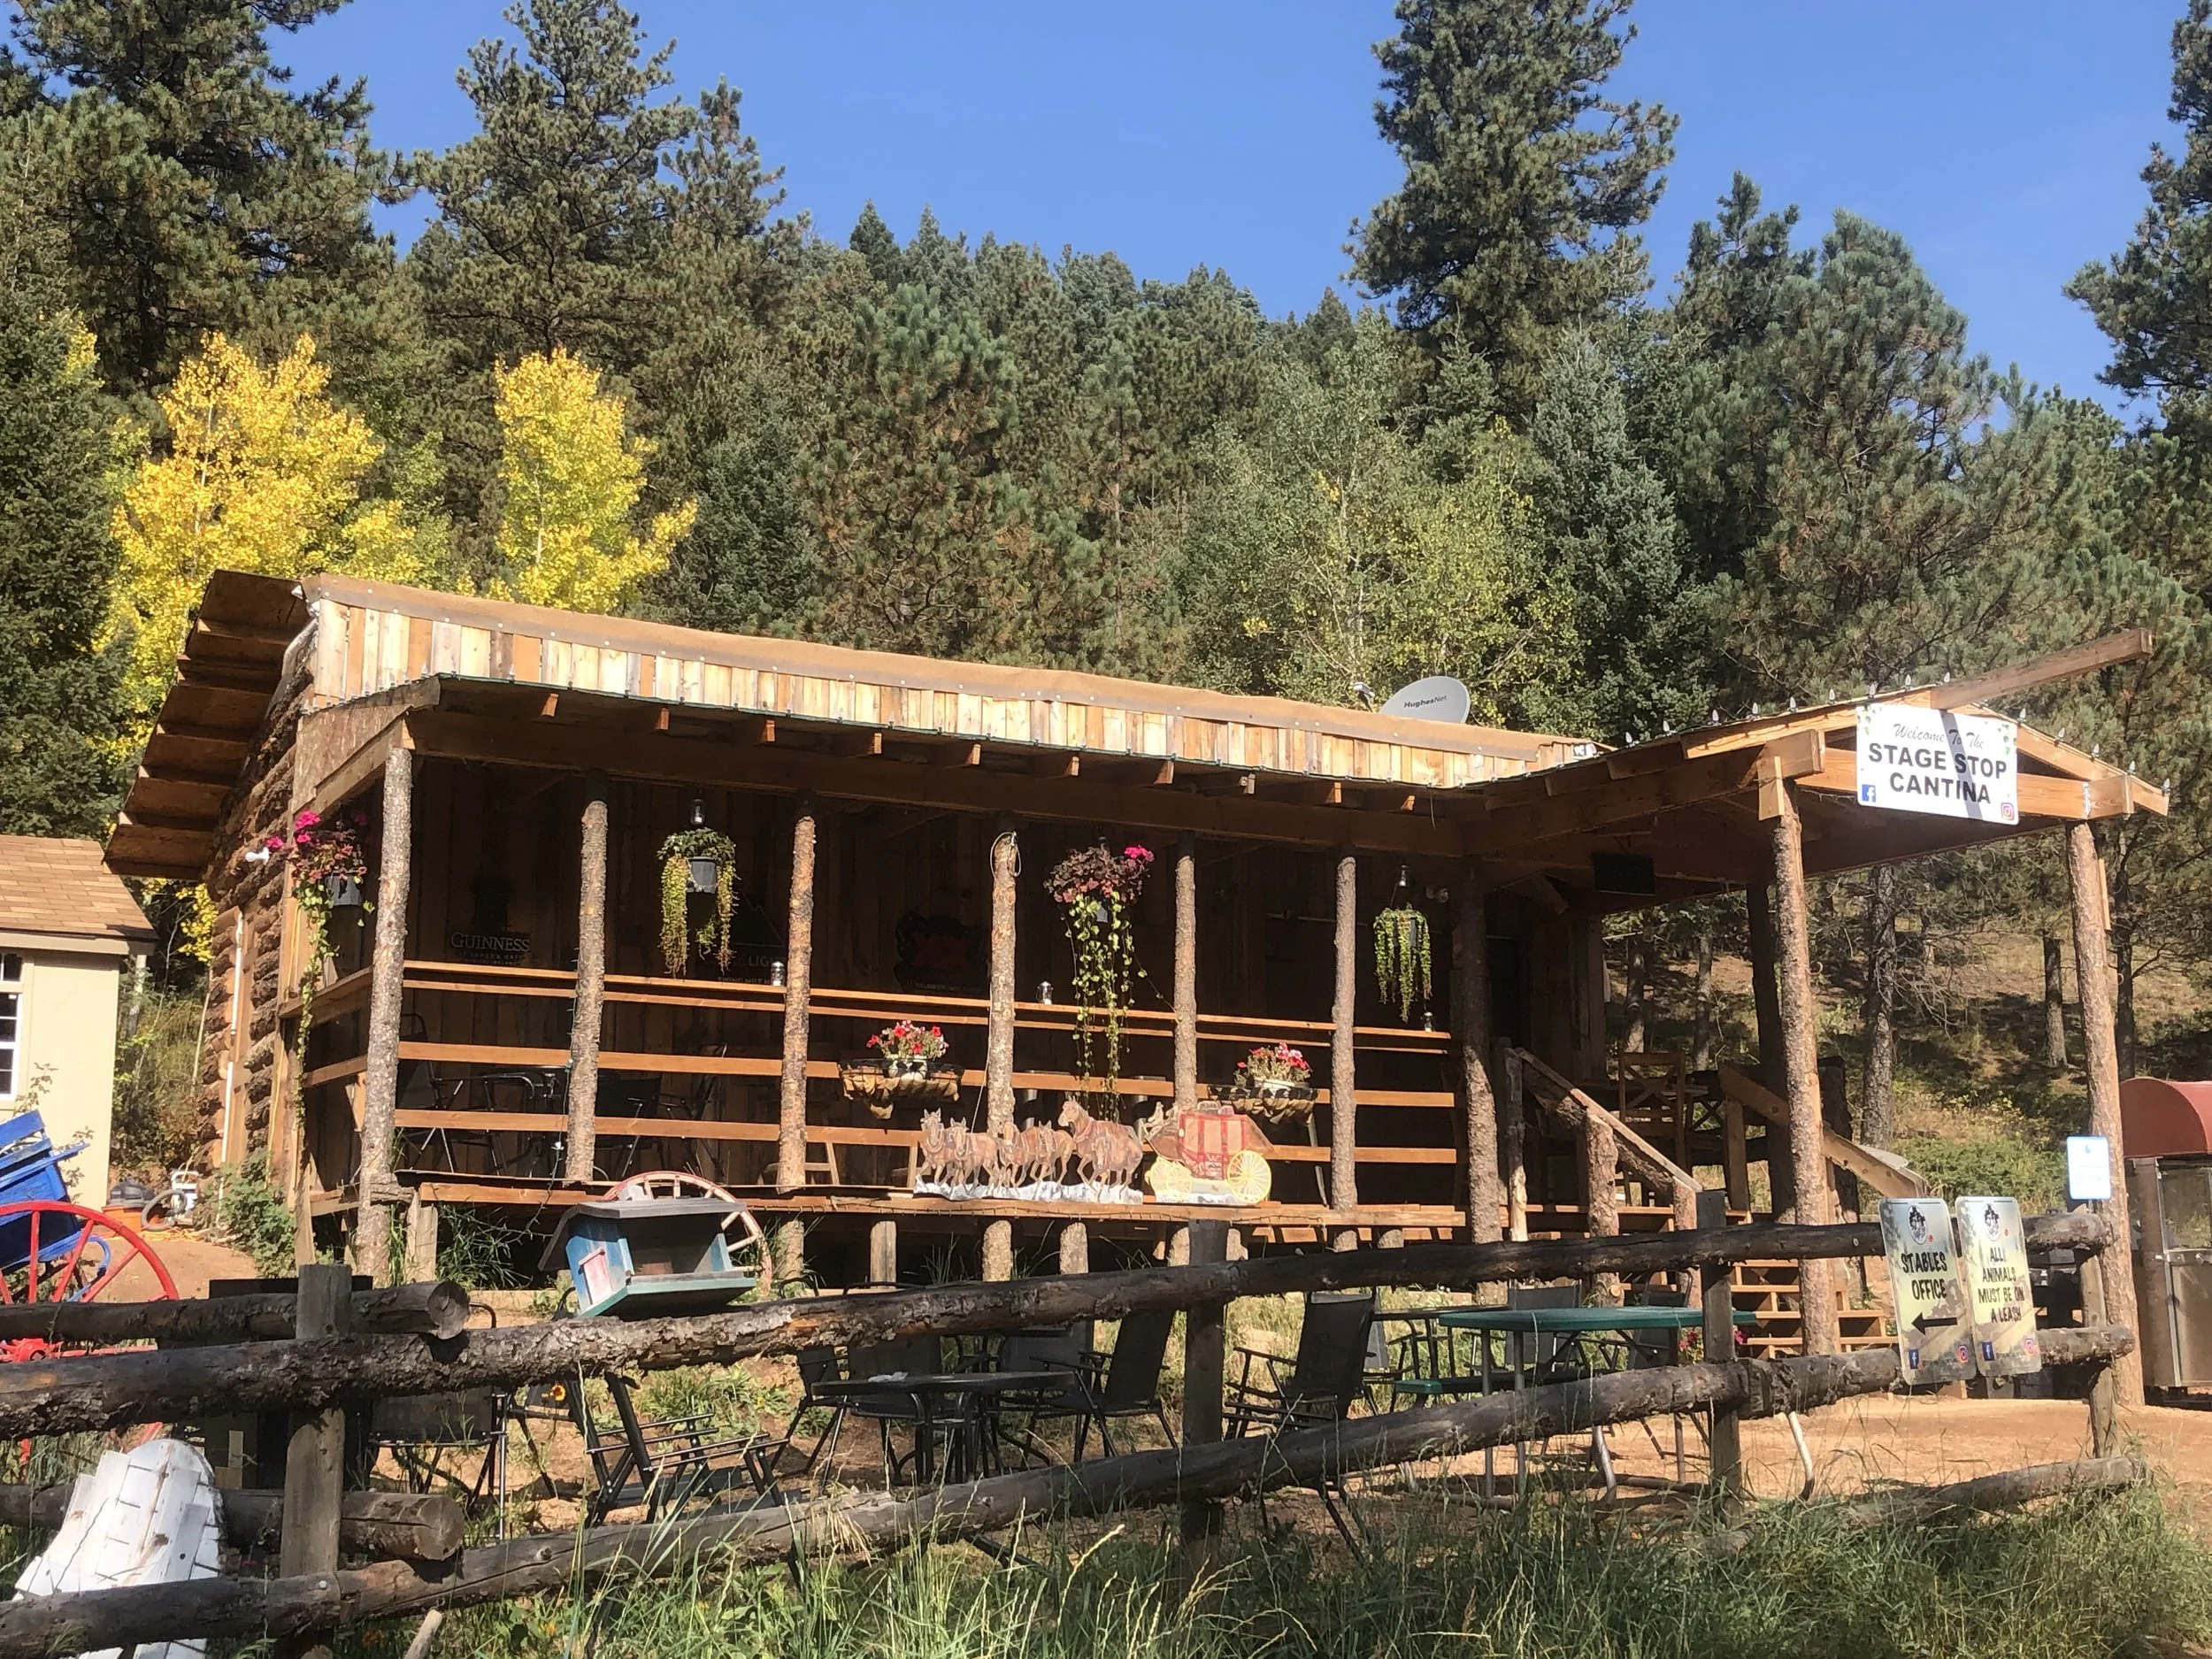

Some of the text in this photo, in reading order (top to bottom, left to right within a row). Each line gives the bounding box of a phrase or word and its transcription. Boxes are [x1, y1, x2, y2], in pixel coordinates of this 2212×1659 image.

[1403, 695, 1447, 708] HughesNet
[1893, 724, 1984, 749] Welcome To The
[1869, 742, 2007, 779] STAGE STOP
[1890, 772, 1991, 803] CANTINA
[451, 932, 531, 952] GUINNESS
[749, 955, 787, 967] LIG
[1901, 1252, 1947, 1273] STABLES
[1990, 1247, 2004, 1263] ALL
[1982, 1266, 2016, 1282] ANIMALS
[1911, 1279, 1947, 1301] OFFICE
[1978, 1286, 2025, 1303] MUST BE ON
[1991, 1307, 2022, 1323] A LEASH
